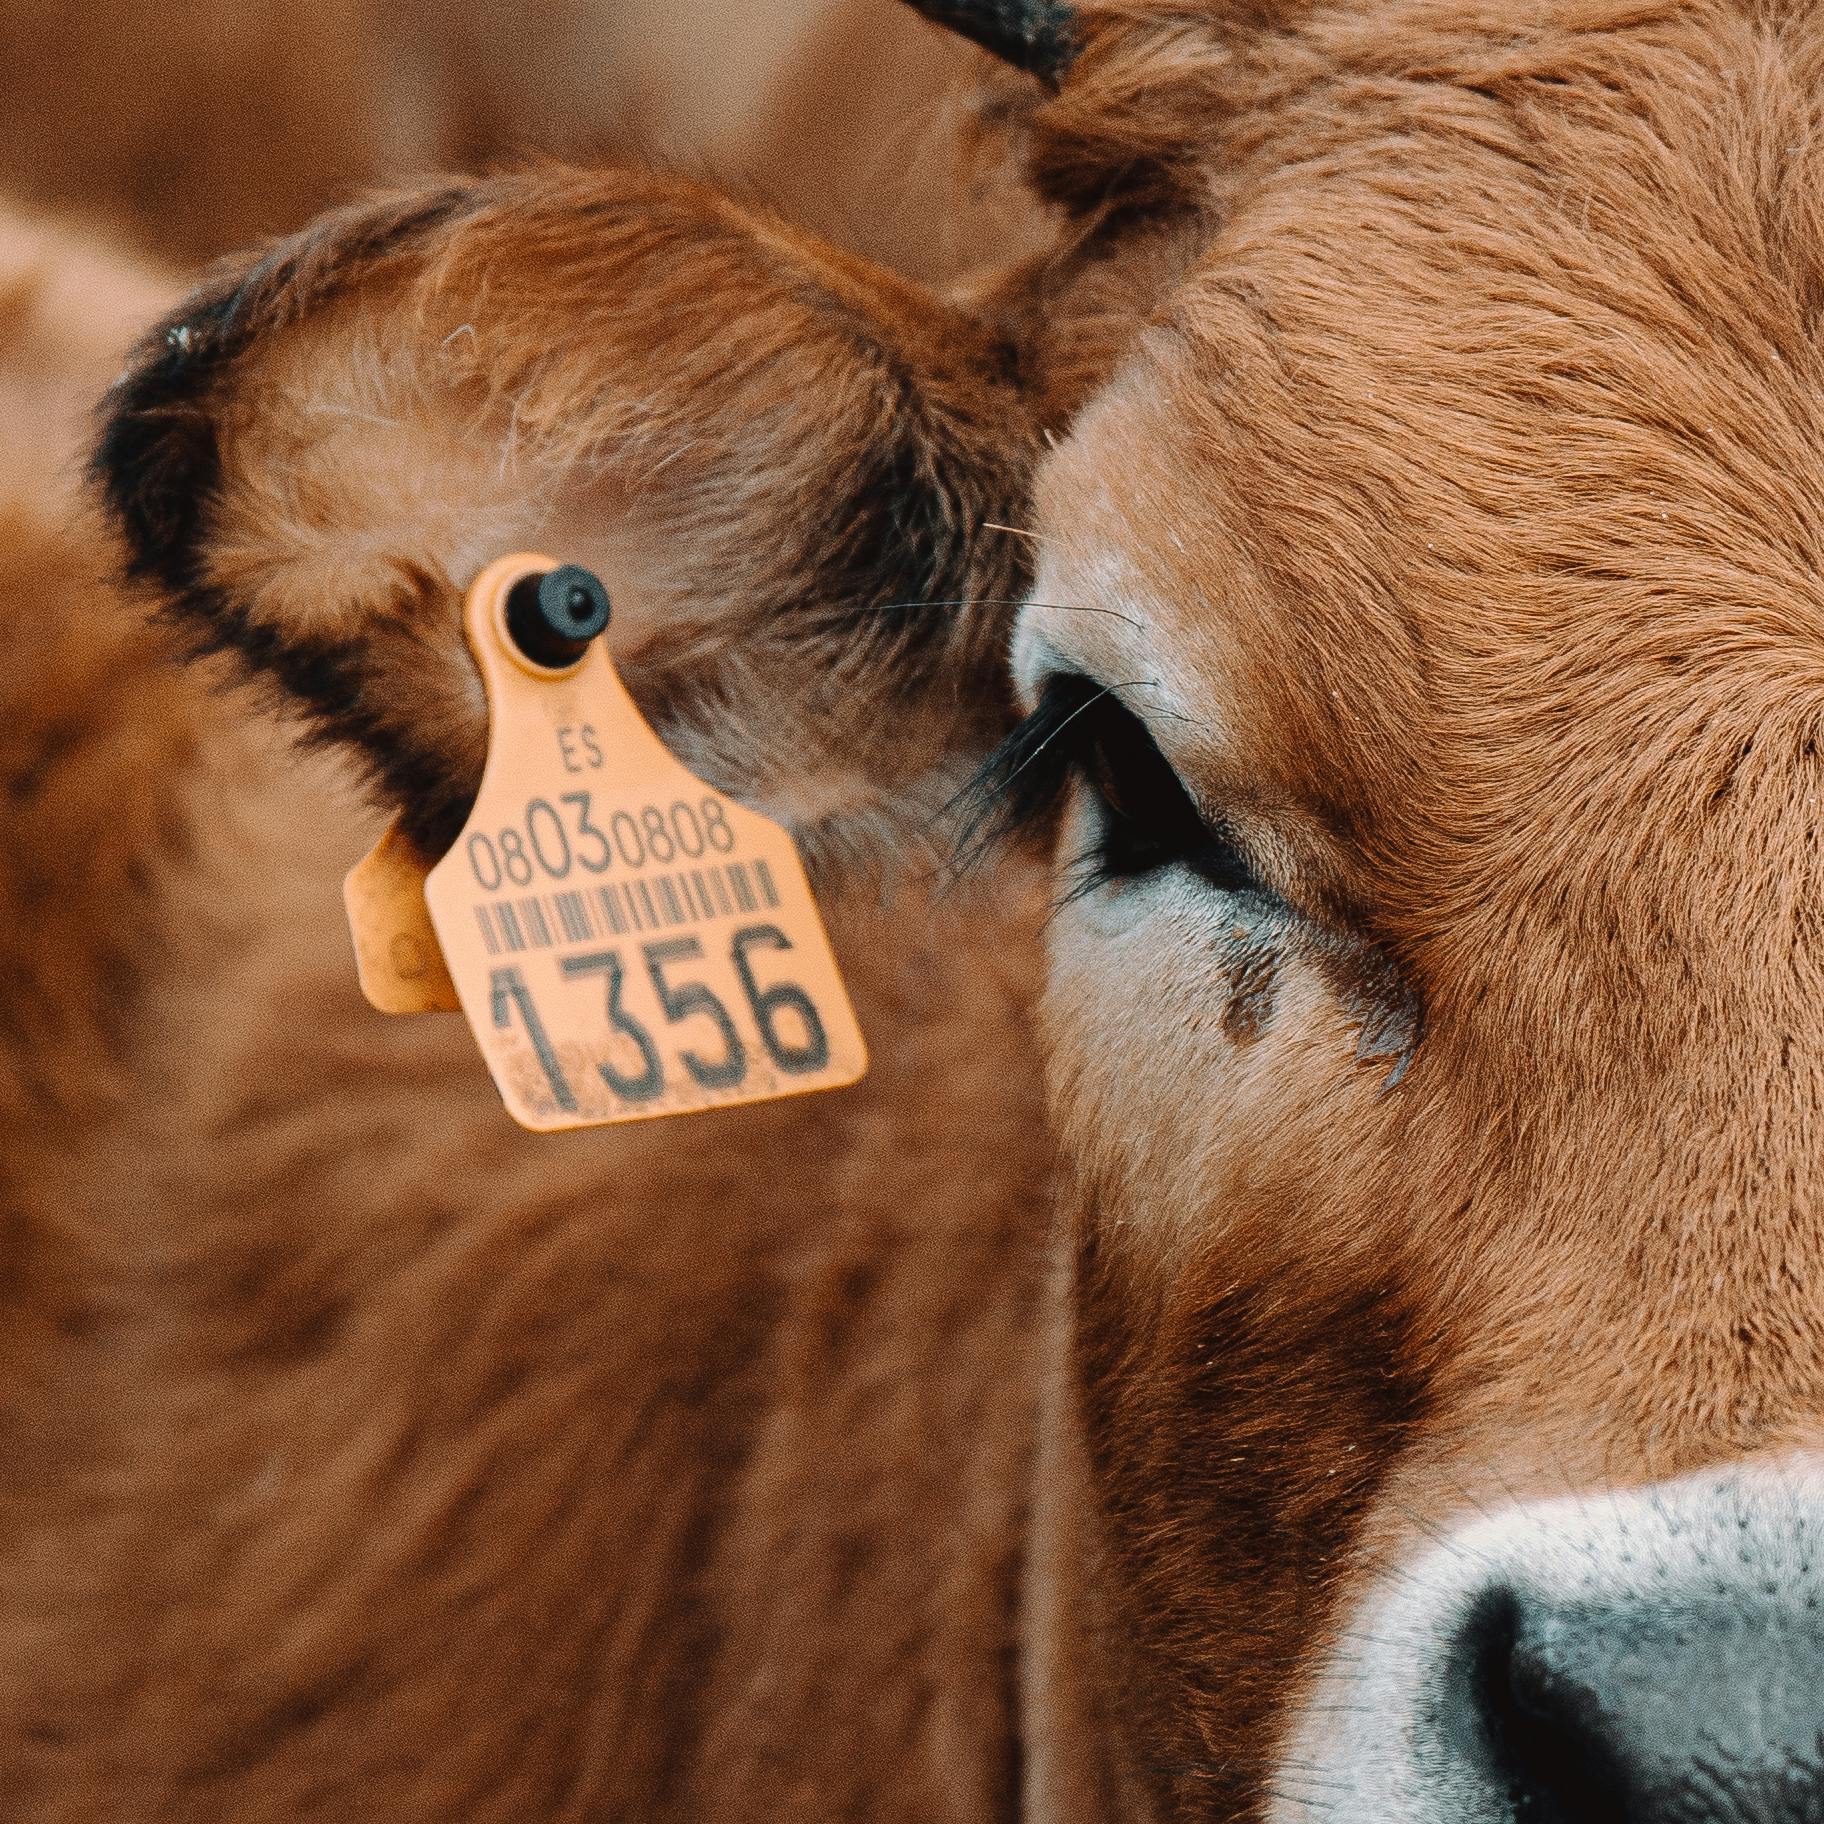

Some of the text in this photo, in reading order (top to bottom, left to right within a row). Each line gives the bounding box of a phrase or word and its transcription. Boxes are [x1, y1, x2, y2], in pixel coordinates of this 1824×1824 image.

[556, 724, 603, 774] ES
[467, 790, 735, 891] 08030808
[487, 923, 830, 1113] 1356
